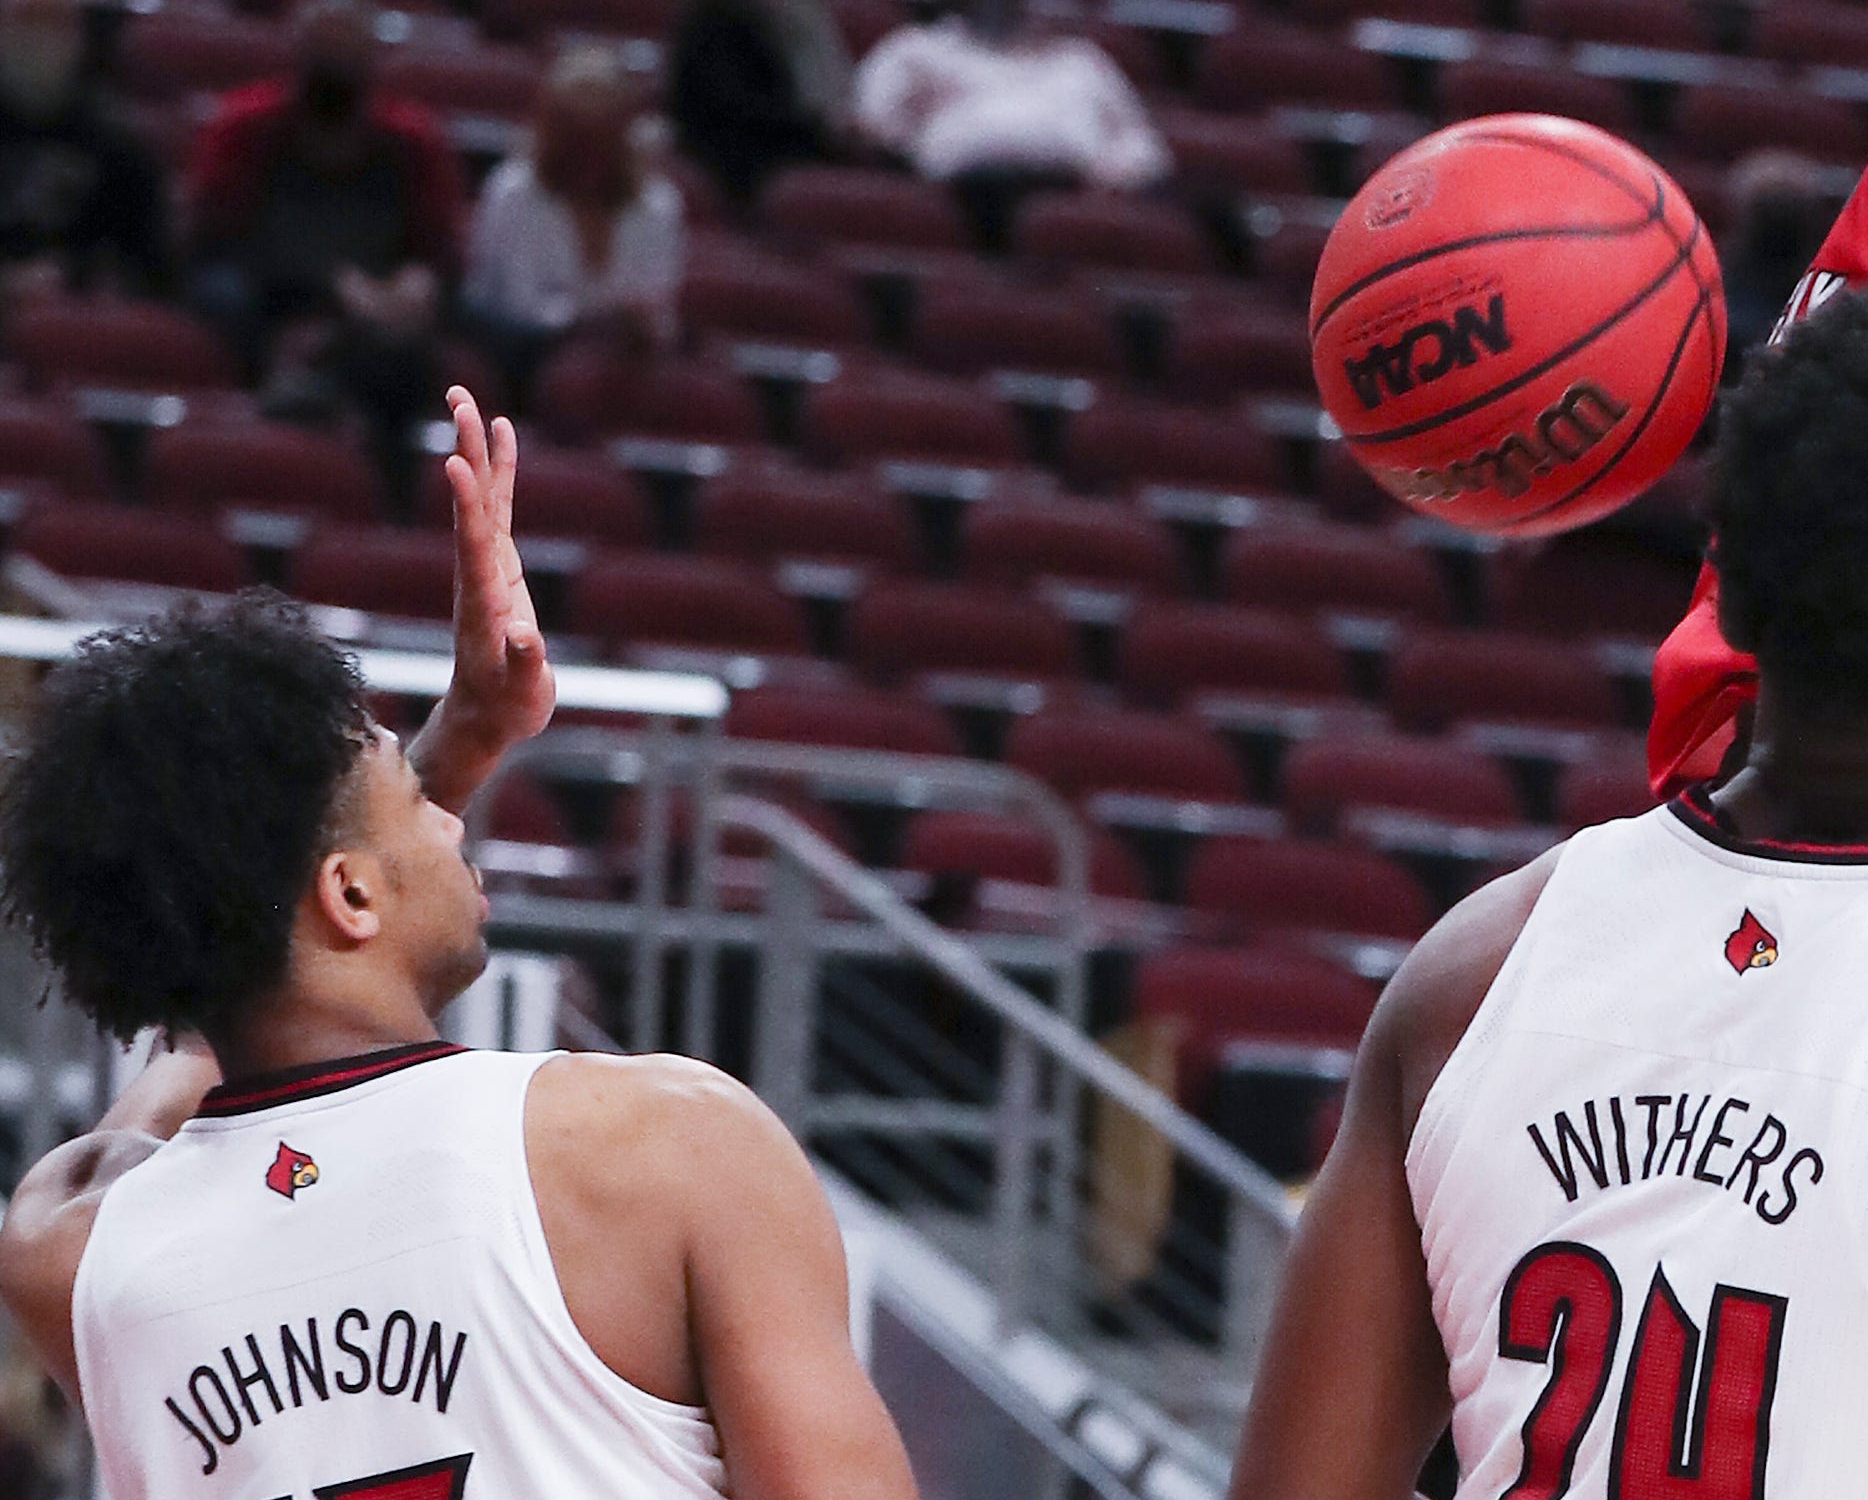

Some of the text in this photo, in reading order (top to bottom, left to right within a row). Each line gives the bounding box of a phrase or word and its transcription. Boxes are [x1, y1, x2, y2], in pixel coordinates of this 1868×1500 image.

[1343, 293, 1511, 410] NCAA
[1526, 1093, 1824, 1226] WITHERS
[165, 1307, 468, 1475] JOHNSON
